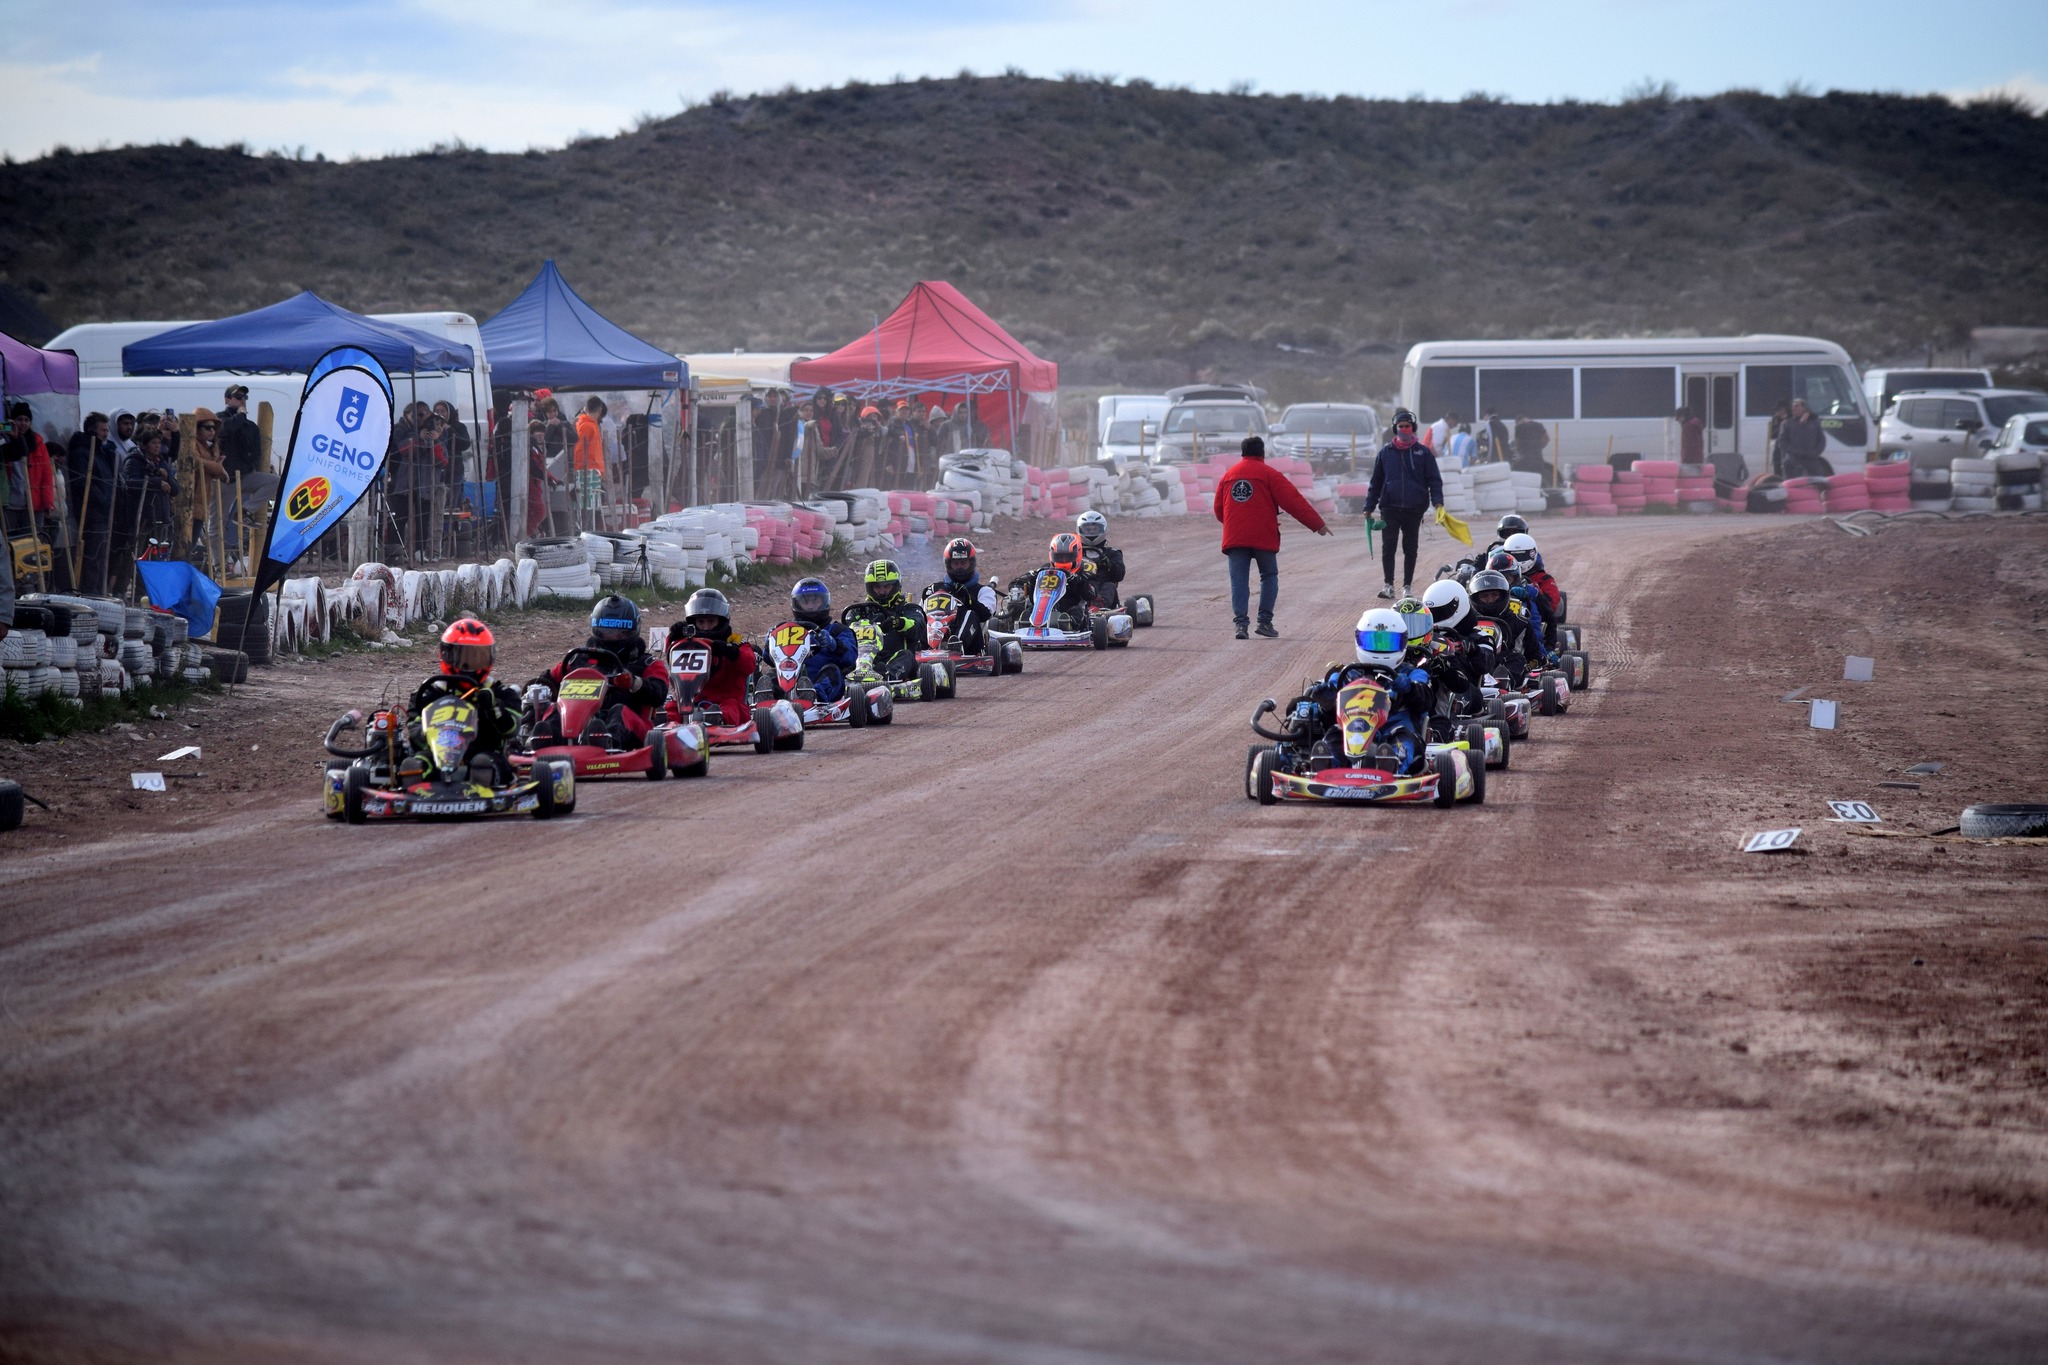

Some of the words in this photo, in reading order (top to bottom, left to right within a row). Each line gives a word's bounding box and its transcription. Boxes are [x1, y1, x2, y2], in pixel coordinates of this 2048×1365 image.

[311, 433, 375, 471] GENO
[307, 453, 371, 484] UNIFORMES
[1040, 575, 1059, 588] 39
[926, 597, 951, 611] 57
[599, 617, 633, 629] NEGRITO
[775, 626, 805, 647] 42
[672, 652, 707, 671] 46
[560, 683, 602, 695] 56
[1344, 688, 1377, 710] 4
[1345, 773, 1382, 782] CAPSULE
[410, 800, 487, 814] NEUQUEN
[1832, 802, 1876, 820] 03
